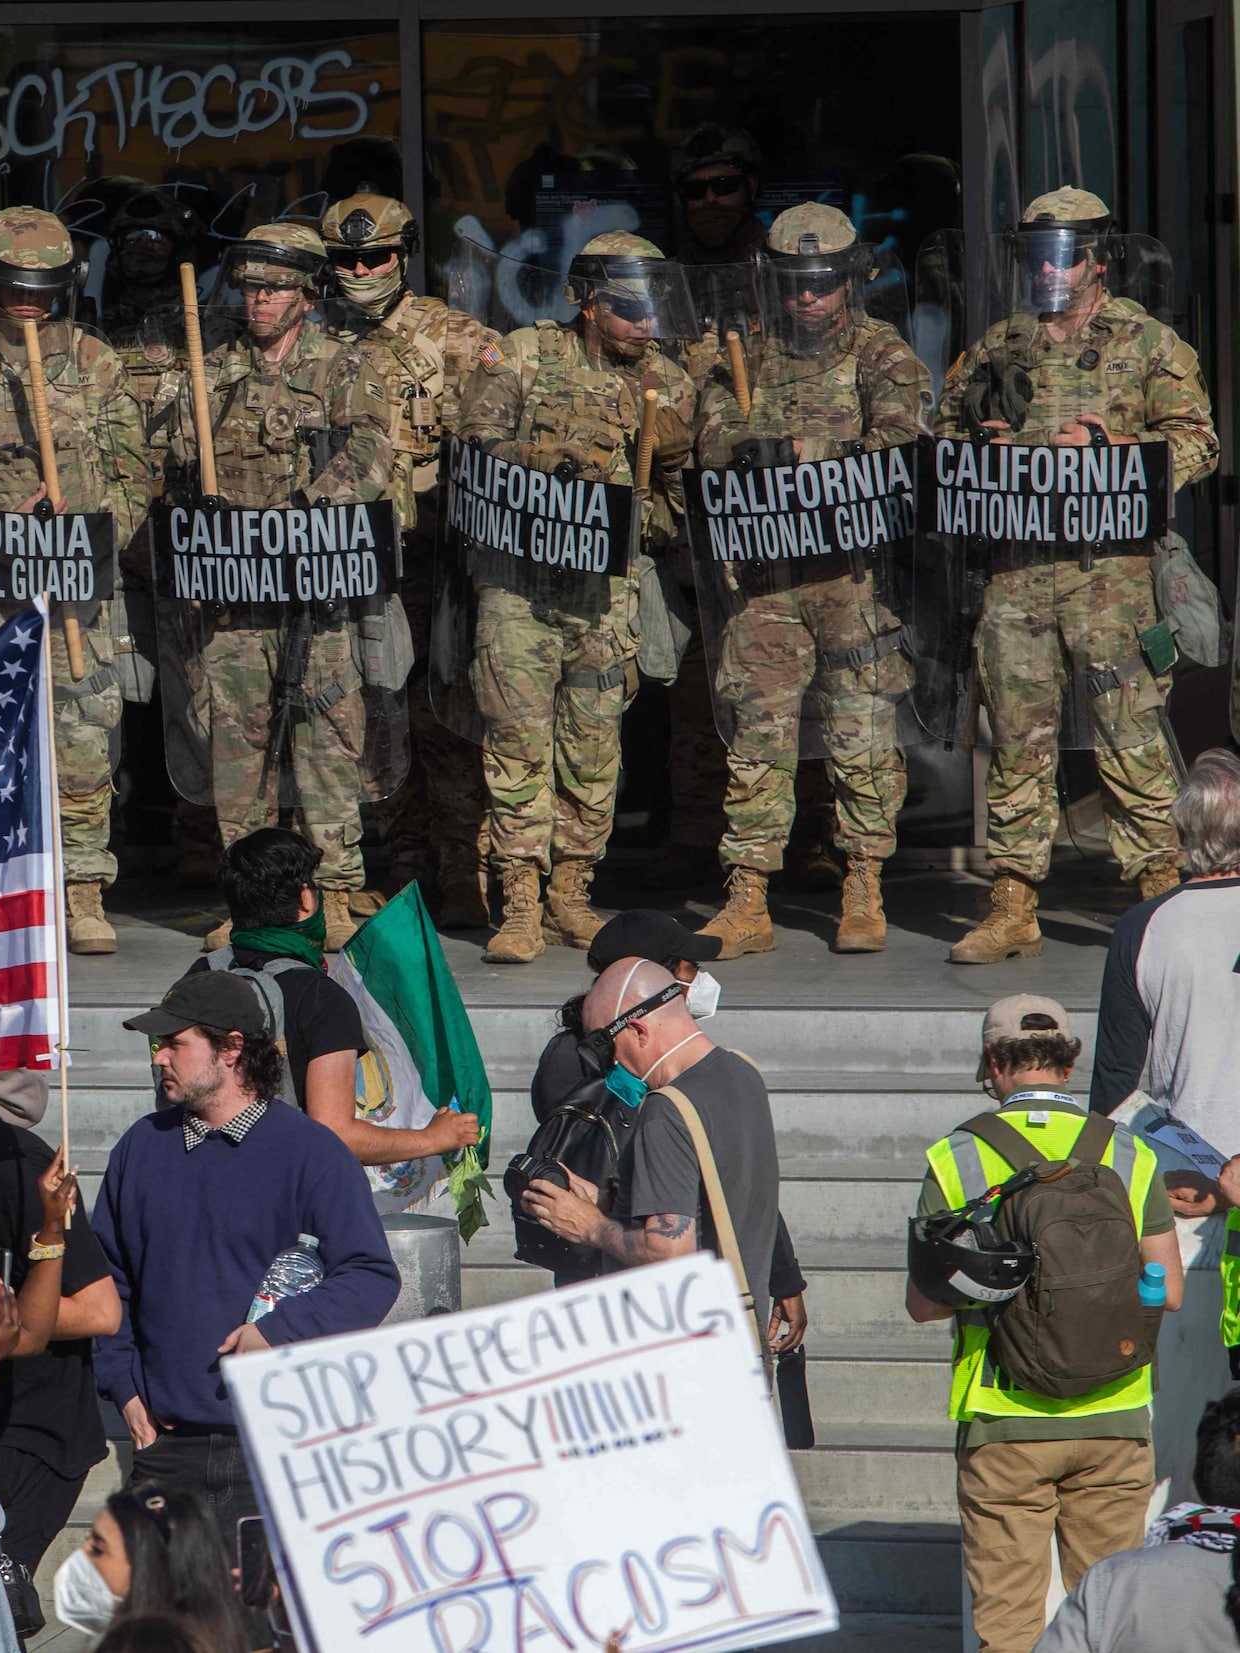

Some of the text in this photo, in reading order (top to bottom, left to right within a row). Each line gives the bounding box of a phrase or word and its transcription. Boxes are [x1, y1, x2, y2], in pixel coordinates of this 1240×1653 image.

[449, 435, 610, 529] CALIFORNIA
[700, 446, 915, 516] CALIFORNIA
[935, 438, 1148, 493] CALIFORNIA
[170, 503, 375, 557] CALIFORNIA
[447, 480, 610, 573] NATIONAL GUARD
[706, 493, 915, 562] NATIONAL GUARD
[936, 486, 1148, 542] NATIONAL GUARD
[11, 555, 96, 602] GUARD
[173, 550, 379, 602] NATIONAL GUARD
[260, 1272, 735, 1440] STOP REPEATING
[324, 1491, 540, 1623] STOP
